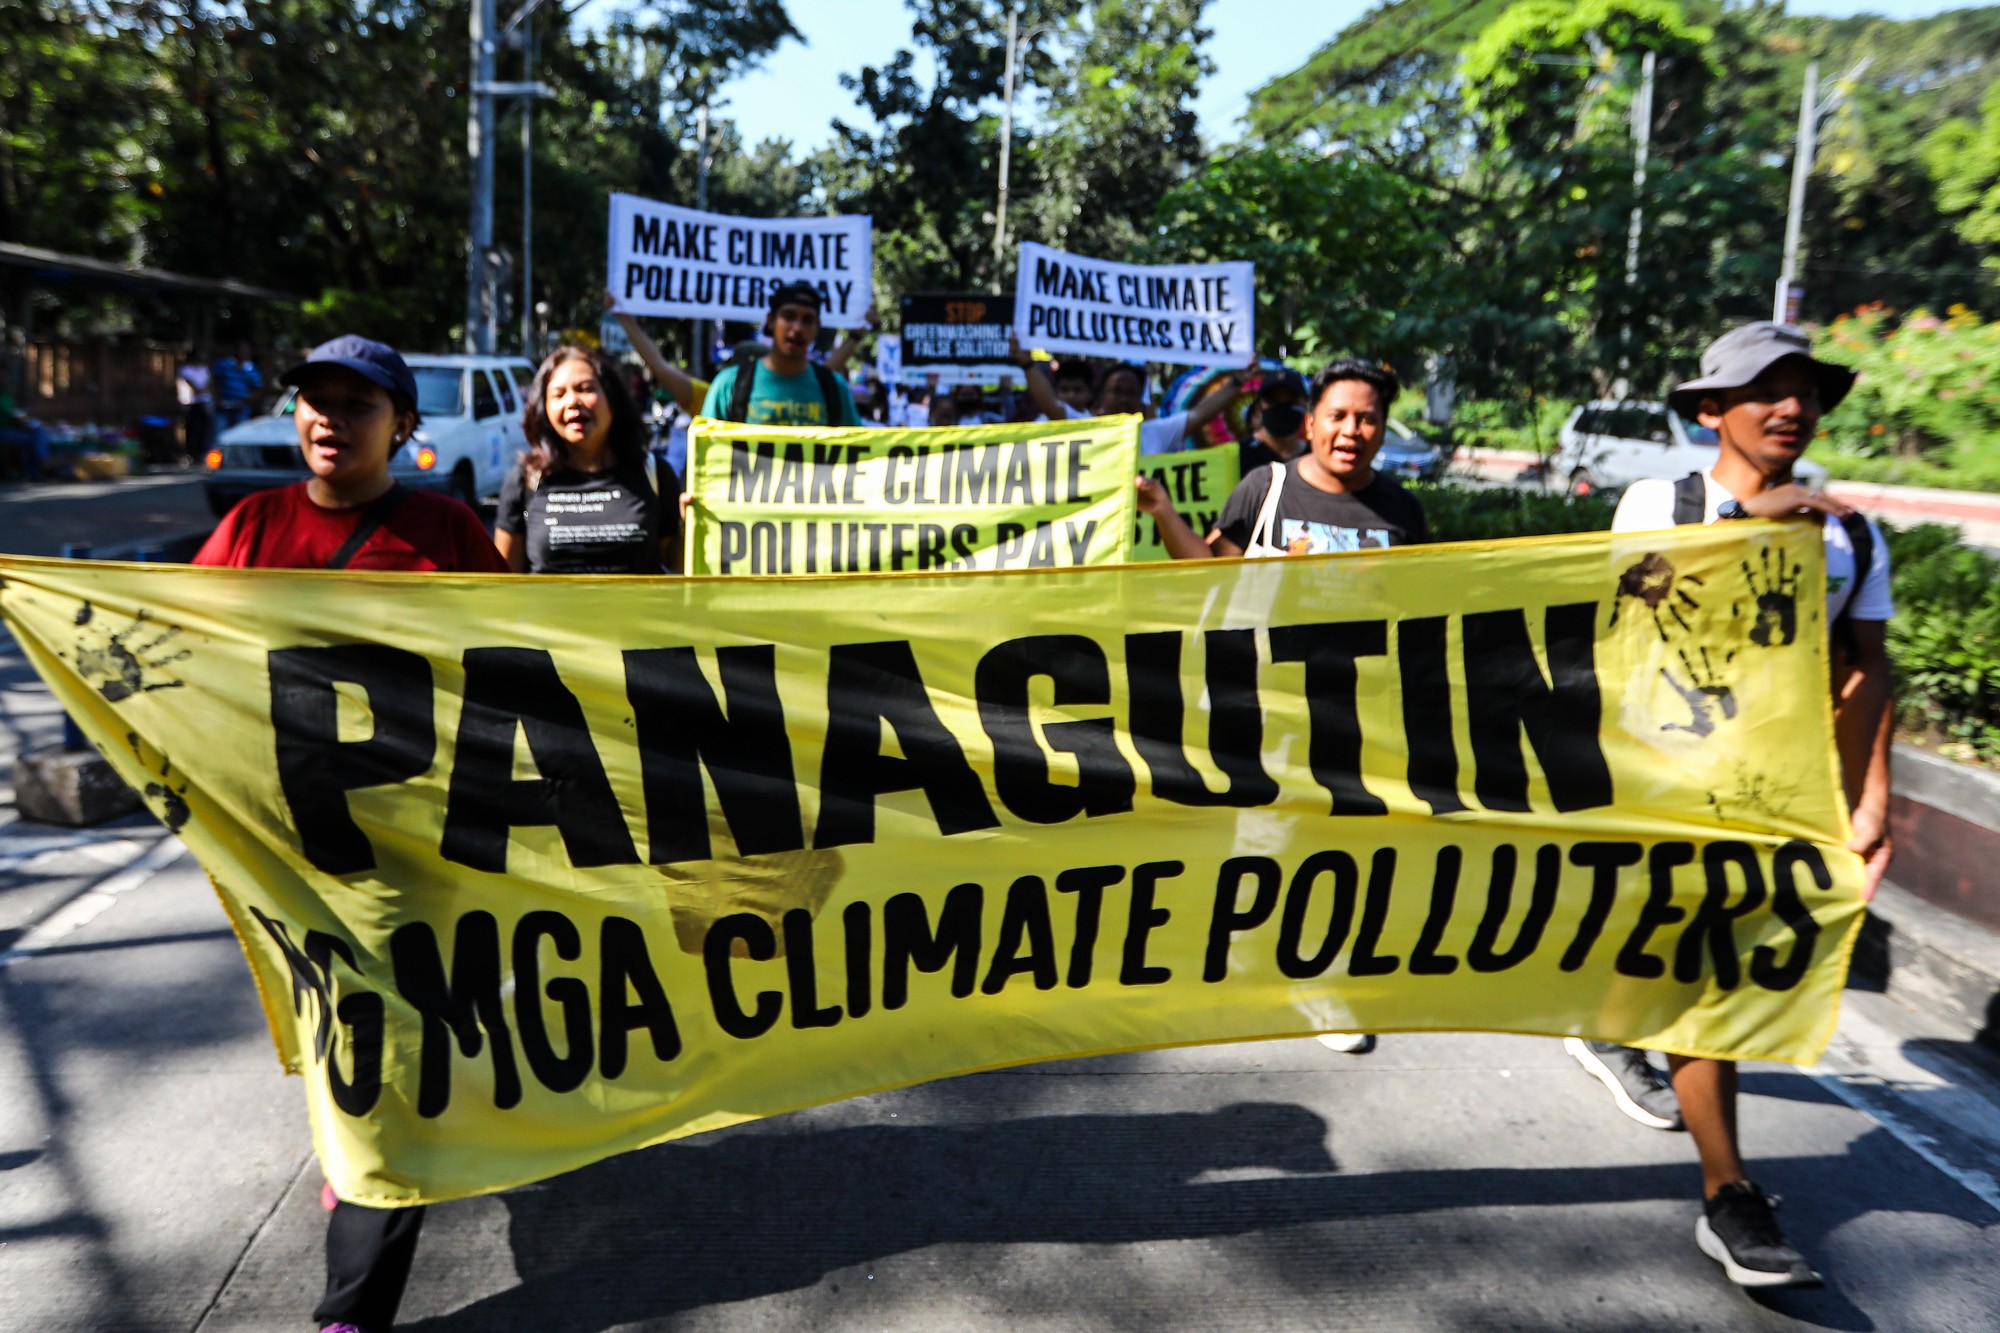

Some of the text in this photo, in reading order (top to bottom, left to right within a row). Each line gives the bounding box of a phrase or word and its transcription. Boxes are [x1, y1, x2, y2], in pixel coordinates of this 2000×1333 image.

[633, 214, 849, 271] MAKE CLIMATE
[800, 280, 853, 315] AY
[1035, 257, 1231, 313] MAKE CLIMATE
[955, 340, 1010, 357] SOLUTION
[1029, 304, 1173, 349] POLLUTERS
[1180, 321, 1235, 354] PAY
[727, 438, 1092, 505] MAKE CLIMATE
[720, 520, 979, 575] POLLUTERS
[996, 520, 1099, 570] PAY
[268, 601, 1616, 874] PANAGUTIN
[389, 910, 682, 1119] MGA
[704, 859, 1186, 1040] CLIMATE
[1202, 839, 1833, 993] POLLUTERS
